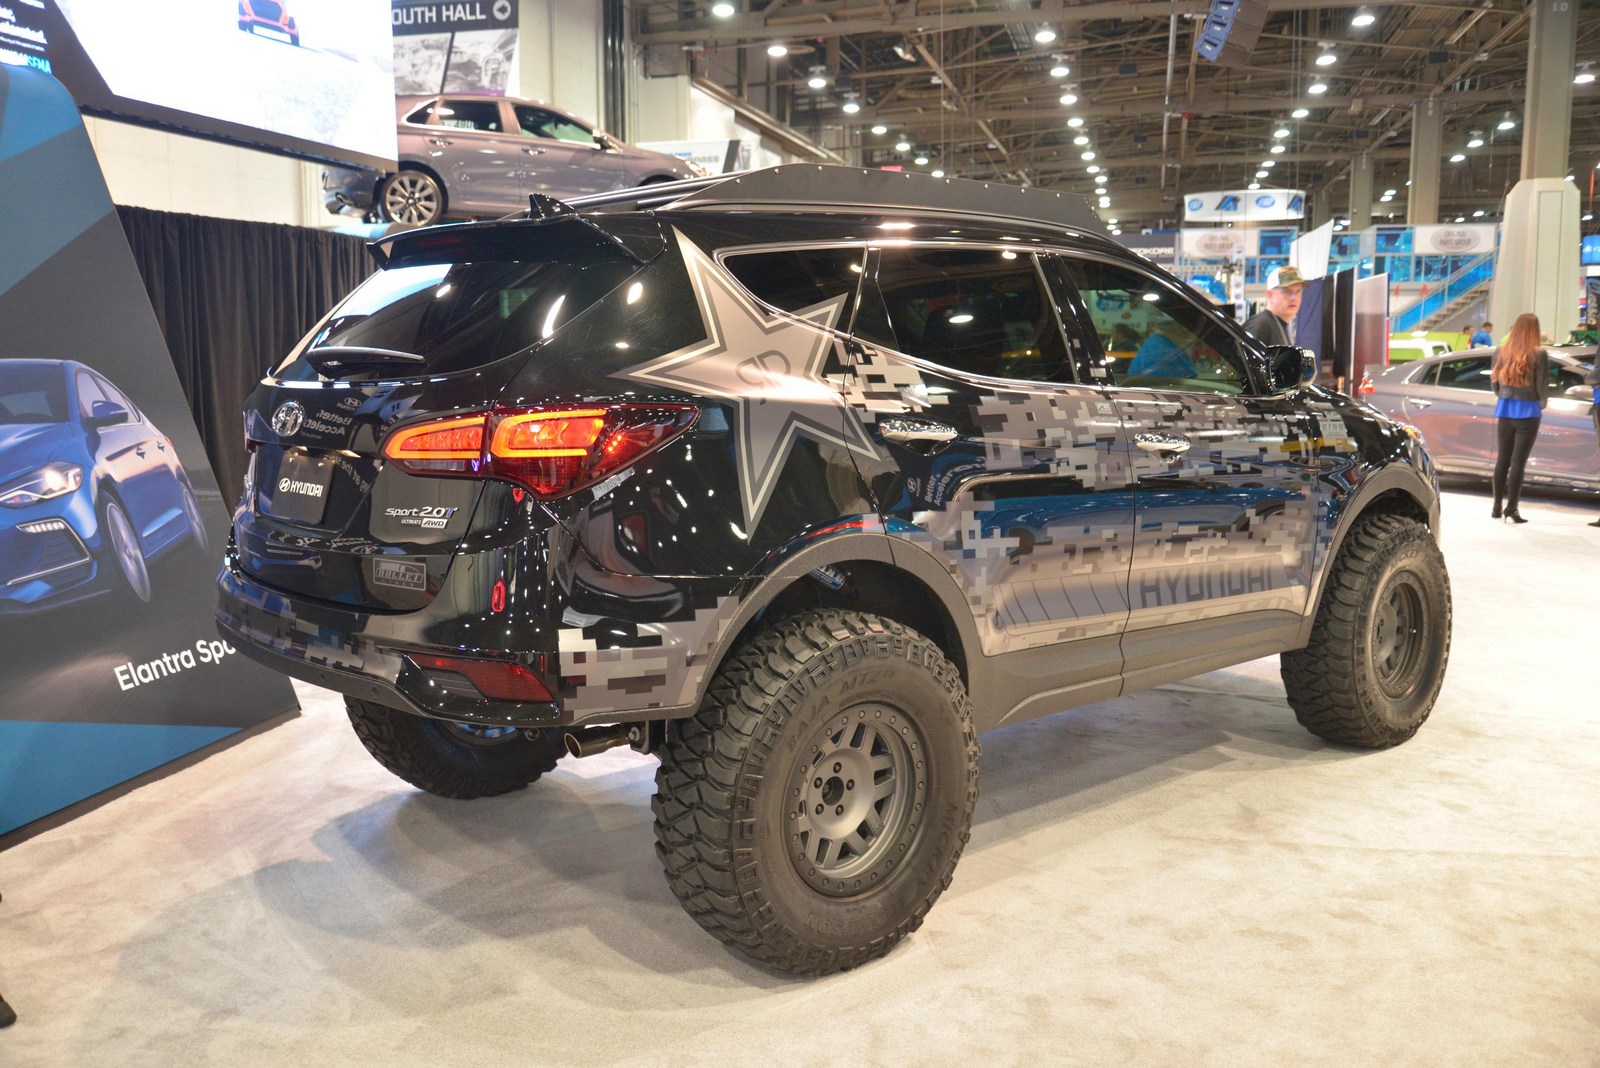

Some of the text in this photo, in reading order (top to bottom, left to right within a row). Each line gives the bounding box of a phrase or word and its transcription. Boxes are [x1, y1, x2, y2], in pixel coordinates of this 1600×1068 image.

[442, 2, 487, 22] HALL
[290, 480, 324, 498] HYUNDAI
[423, 519, 445, 527] AWD
[375, 567, 423, 583] BULLET
[1139, 559, 1273, 609] HYUNDAI
[113, 649, 197, 691] Elantra
